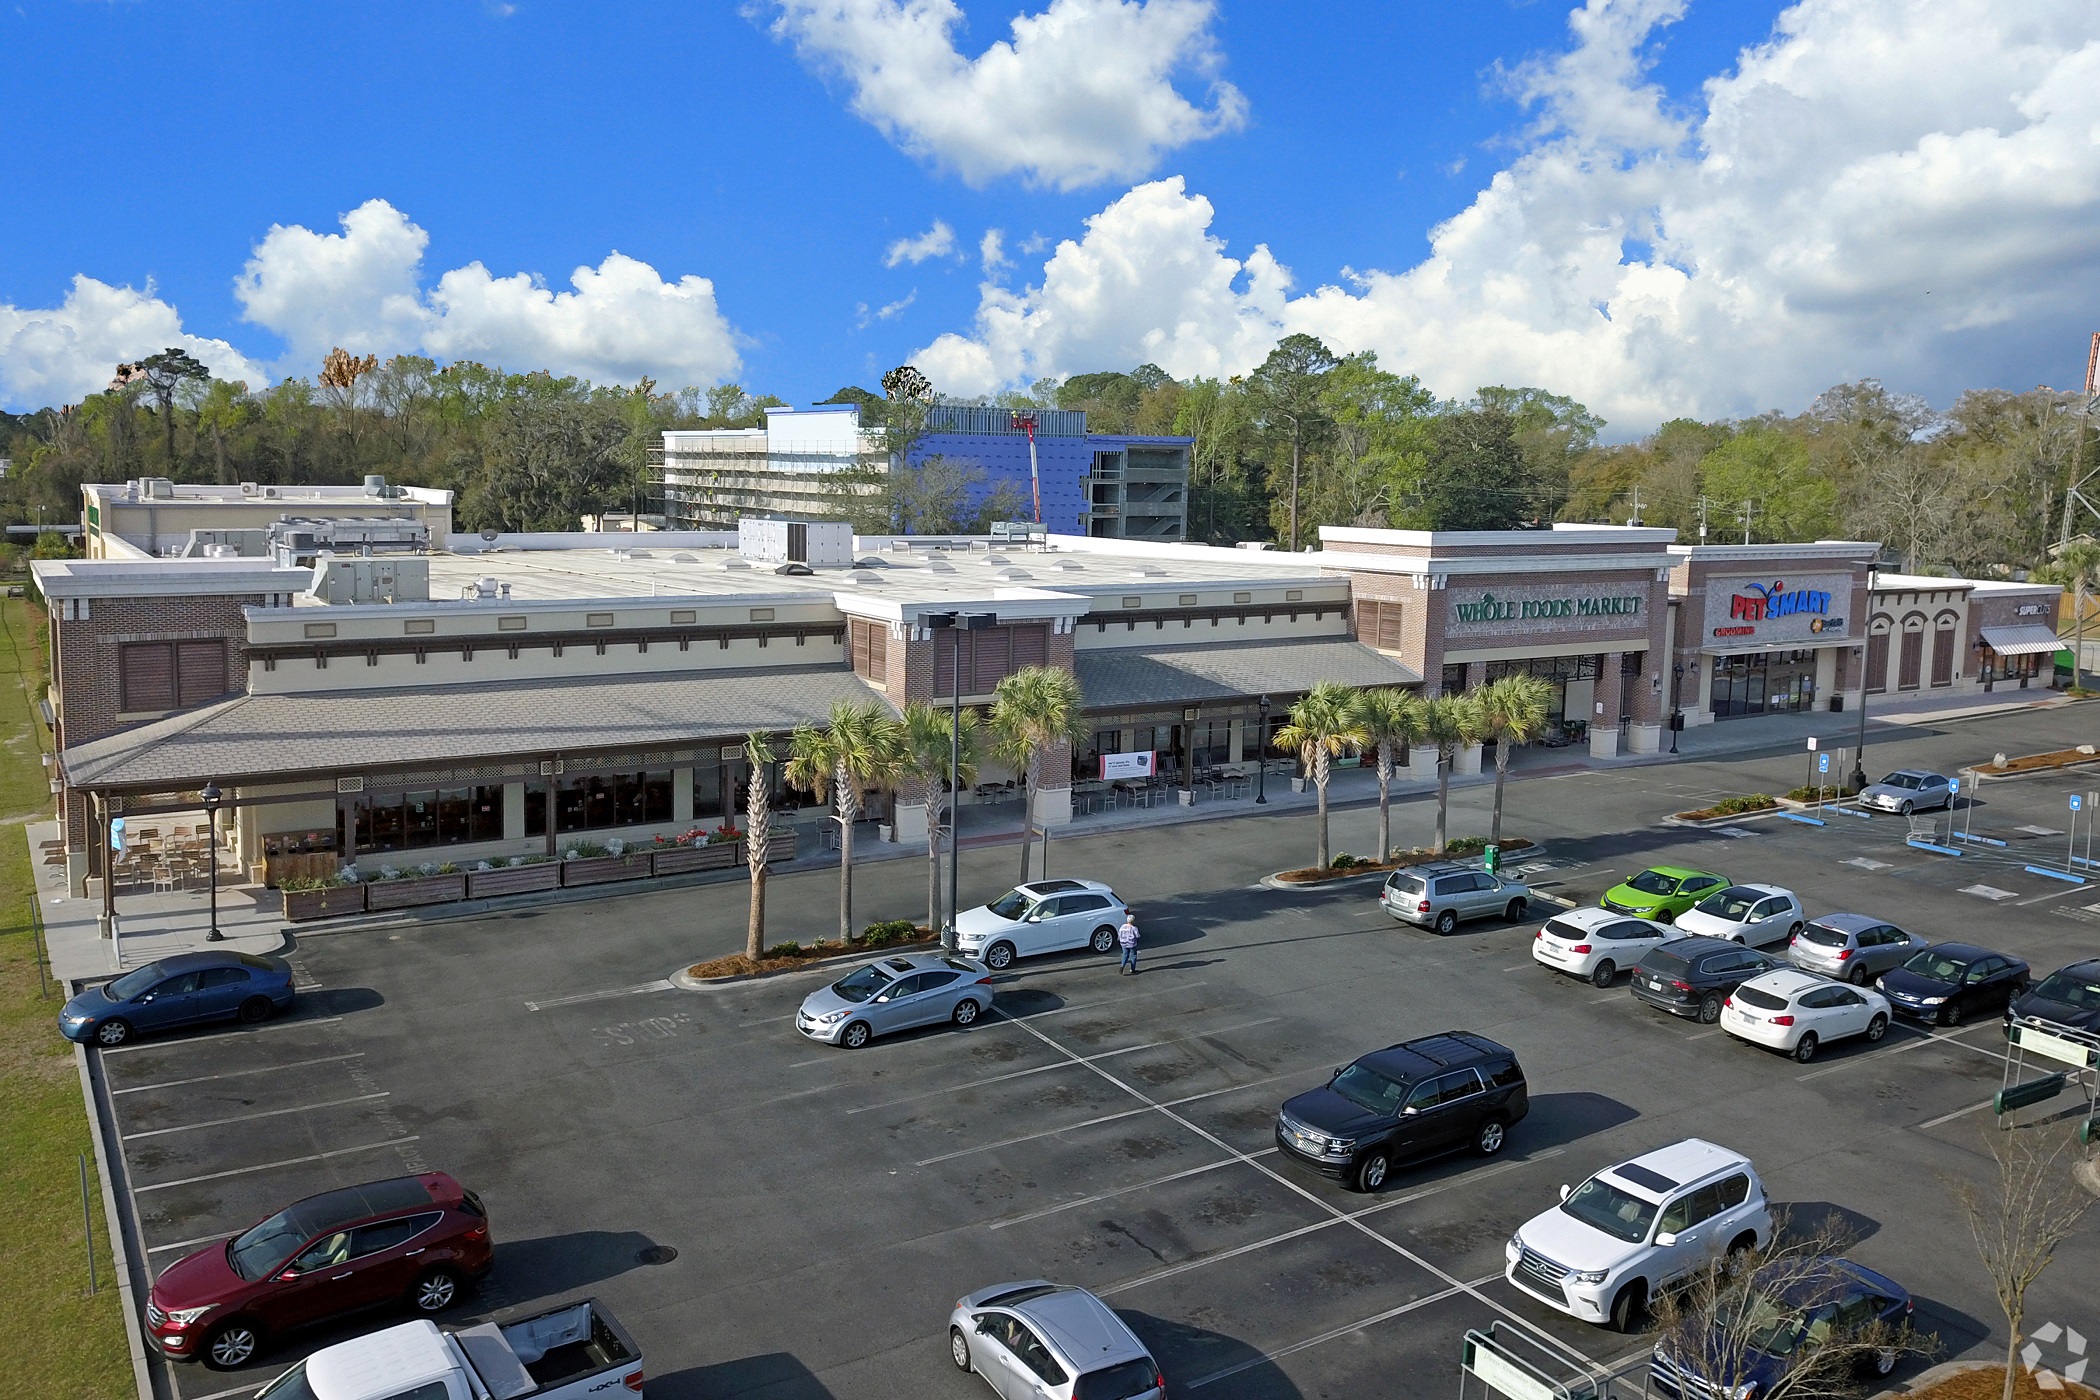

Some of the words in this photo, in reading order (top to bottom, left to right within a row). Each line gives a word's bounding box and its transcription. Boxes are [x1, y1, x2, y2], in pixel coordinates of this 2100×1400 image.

[1456, 598, 1516, 622] WHOLE
[1519, 599, 1573, 619] FOODS
[1575, 596, 1642, 616] MARKET
[1731, 590, 1831, 621] PETSMART
[2018, 604, 2051, 616] SUPERCUTS
[1714, 626, 1755, 637] GROOMING
